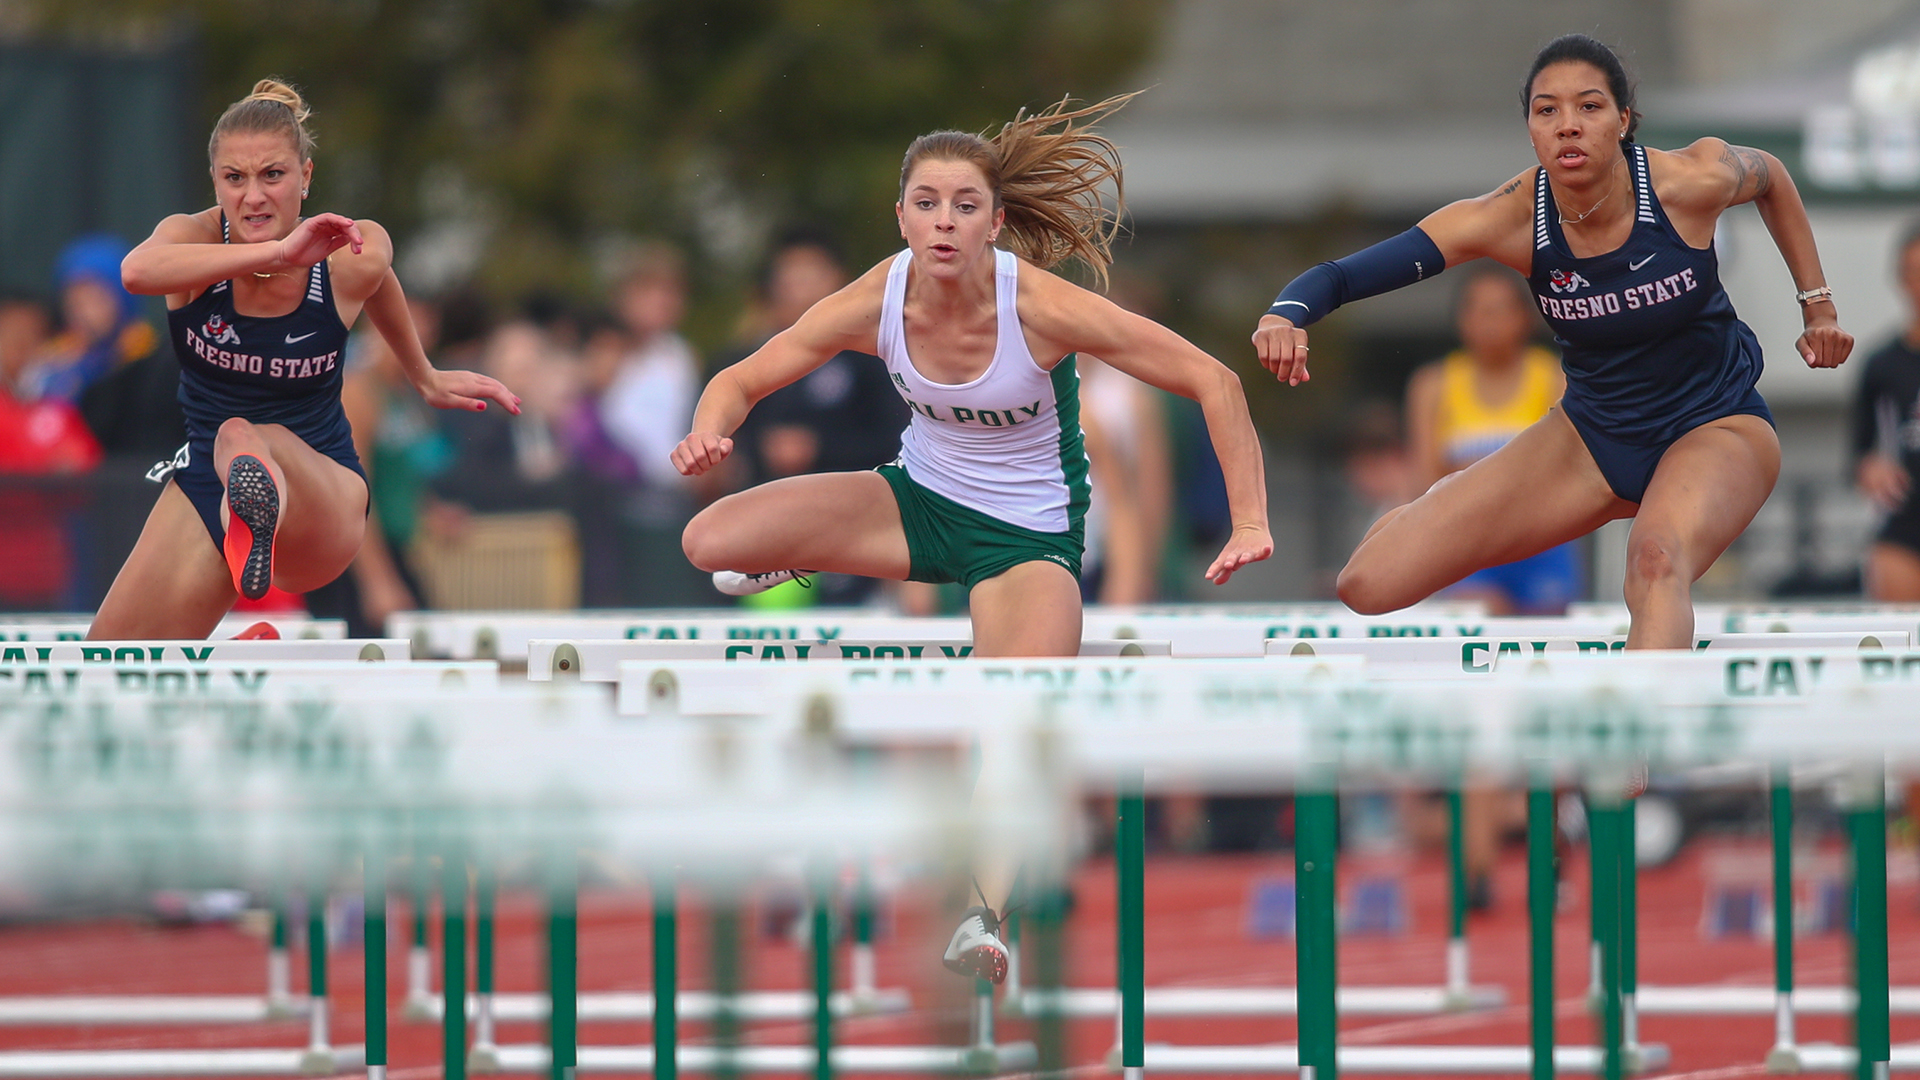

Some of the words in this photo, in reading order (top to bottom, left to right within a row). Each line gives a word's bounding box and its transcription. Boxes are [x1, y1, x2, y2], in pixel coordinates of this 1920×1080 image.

[1538, 293, 1621, 321] FRESNO
[1623, 267, 1698, 310] STATE
[186, 327, 264, 375] FRESNO
[269, 350, 338, 379] STATE
[950, 399, 1041, 427] POLY
